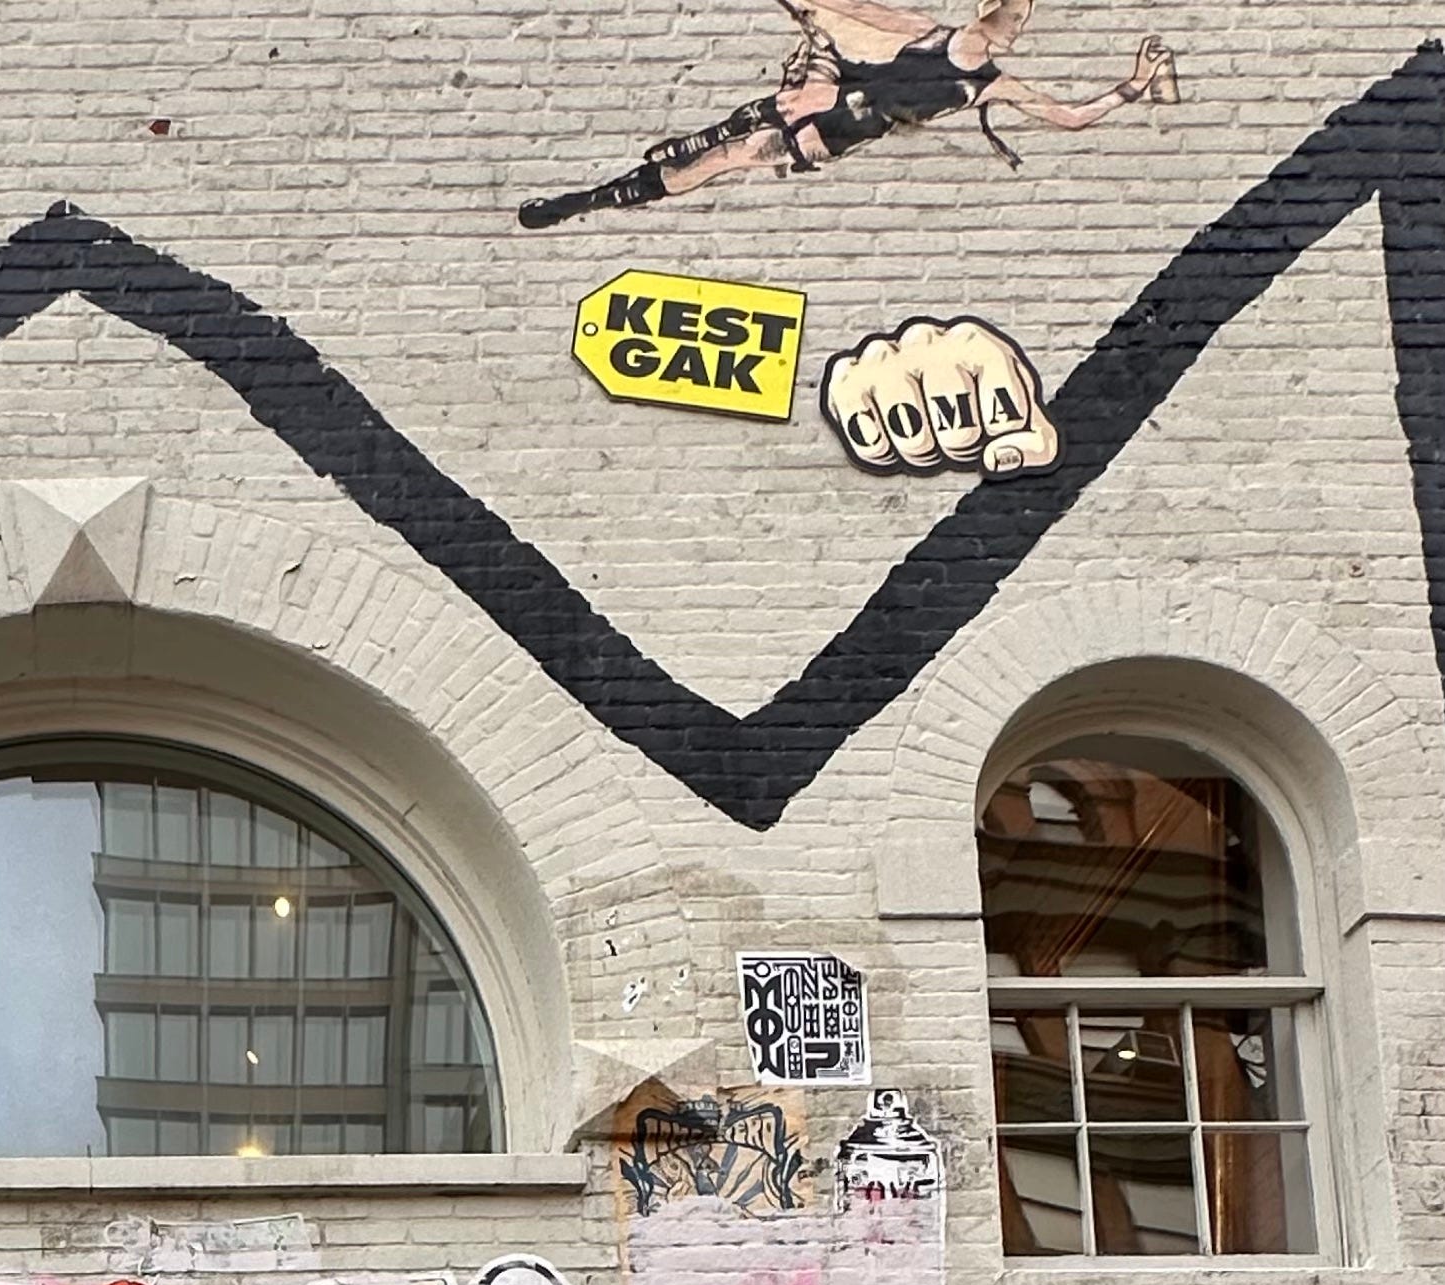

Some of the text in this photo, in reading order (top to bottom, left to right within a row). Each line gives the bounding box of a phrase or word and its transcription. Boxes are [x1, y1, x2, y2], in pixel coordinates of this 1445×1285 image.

[606, 293, 797, 354] KEST
[609, 339, 766, 394] GAK
[847, 386, 1026, 448] COMA
